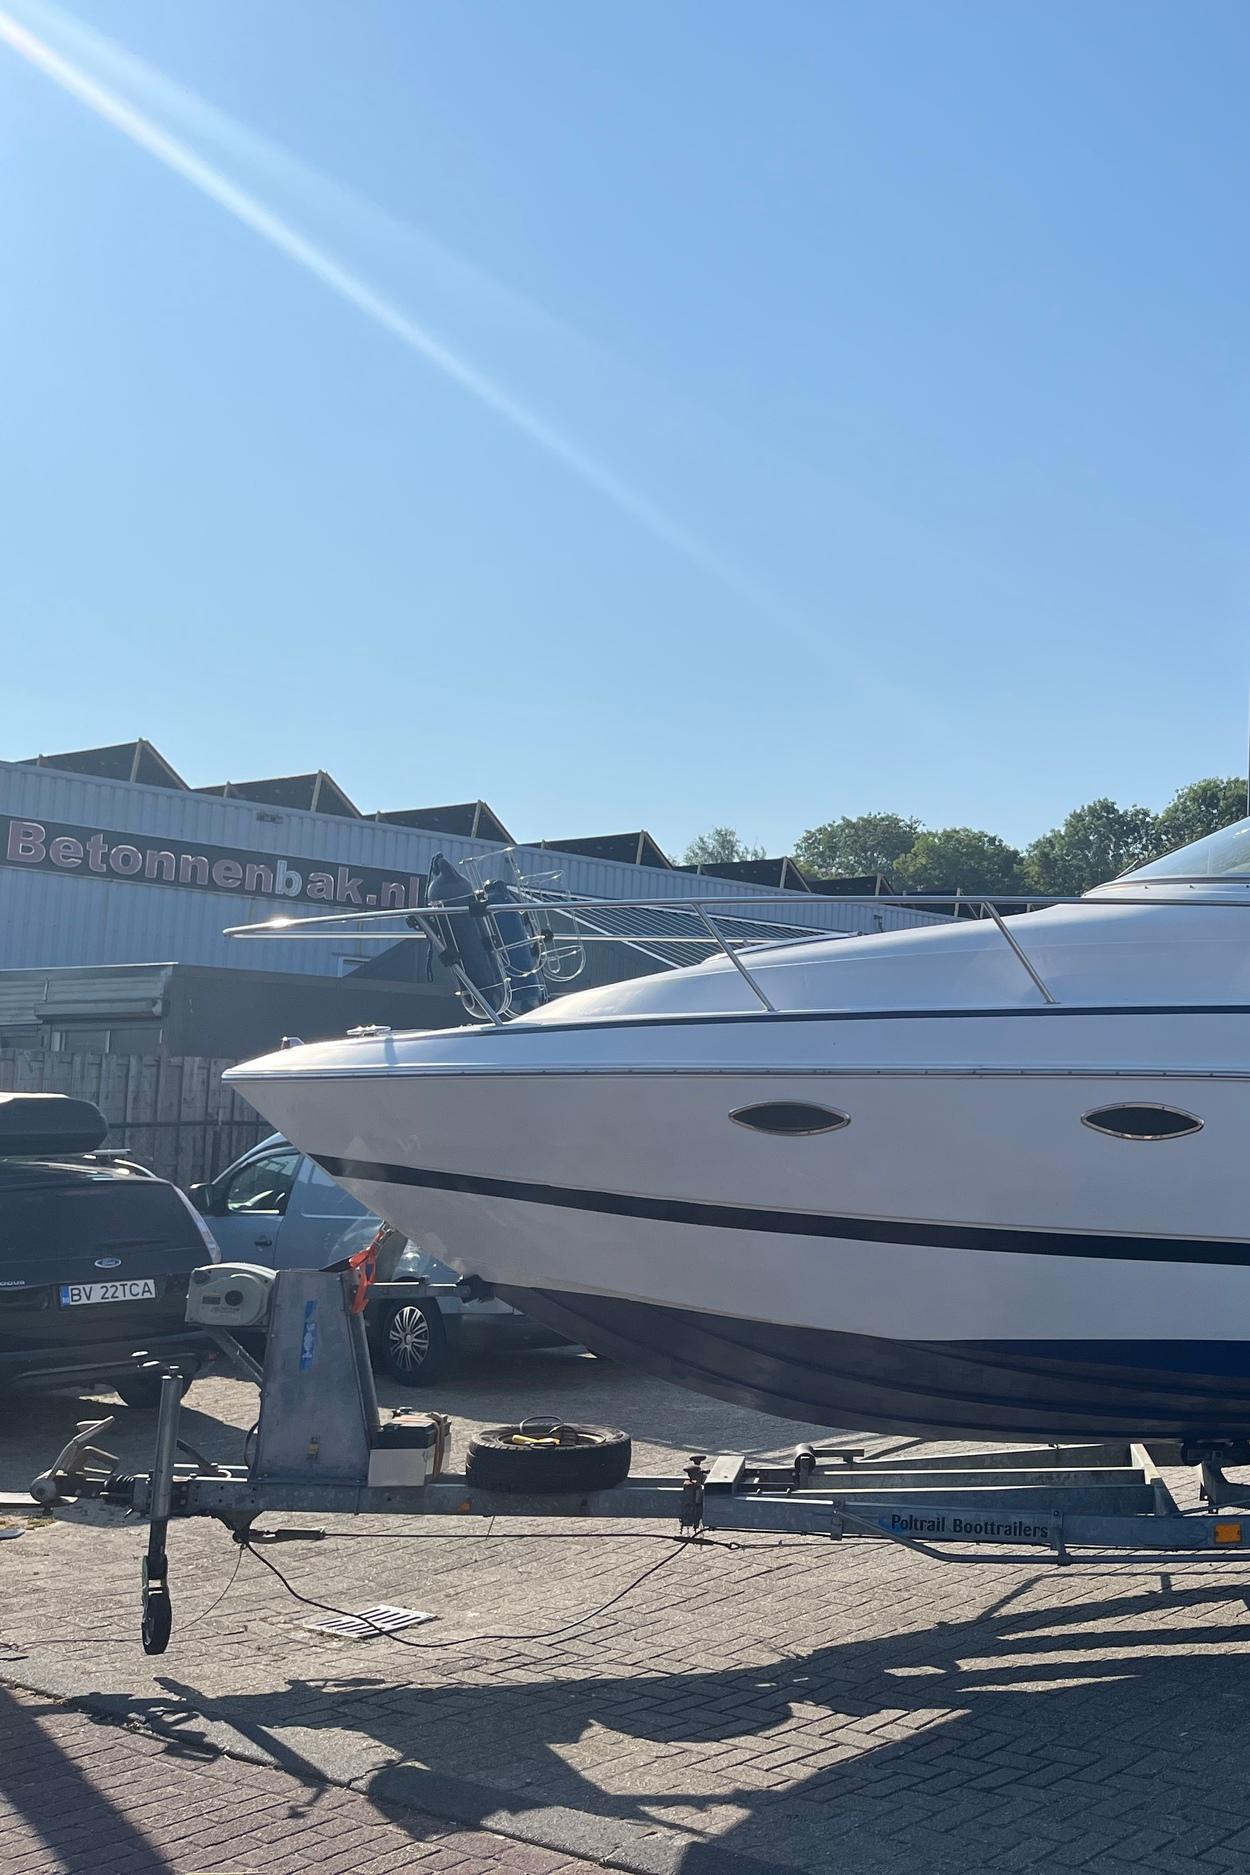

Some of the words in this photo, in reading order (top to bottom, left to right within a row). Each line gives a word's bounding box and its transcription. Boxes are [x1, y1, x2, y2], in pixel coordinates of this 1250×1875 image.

[7, 819, 420, 909] Betonnenbak.nl
[70, 1286, 94, 1303] BV
[100, 1282, 153, 1300] 22TCA
[891, 1514, 945, 1532] Poltrail
[952, 1518, 1048, 1538] Boottrailers
